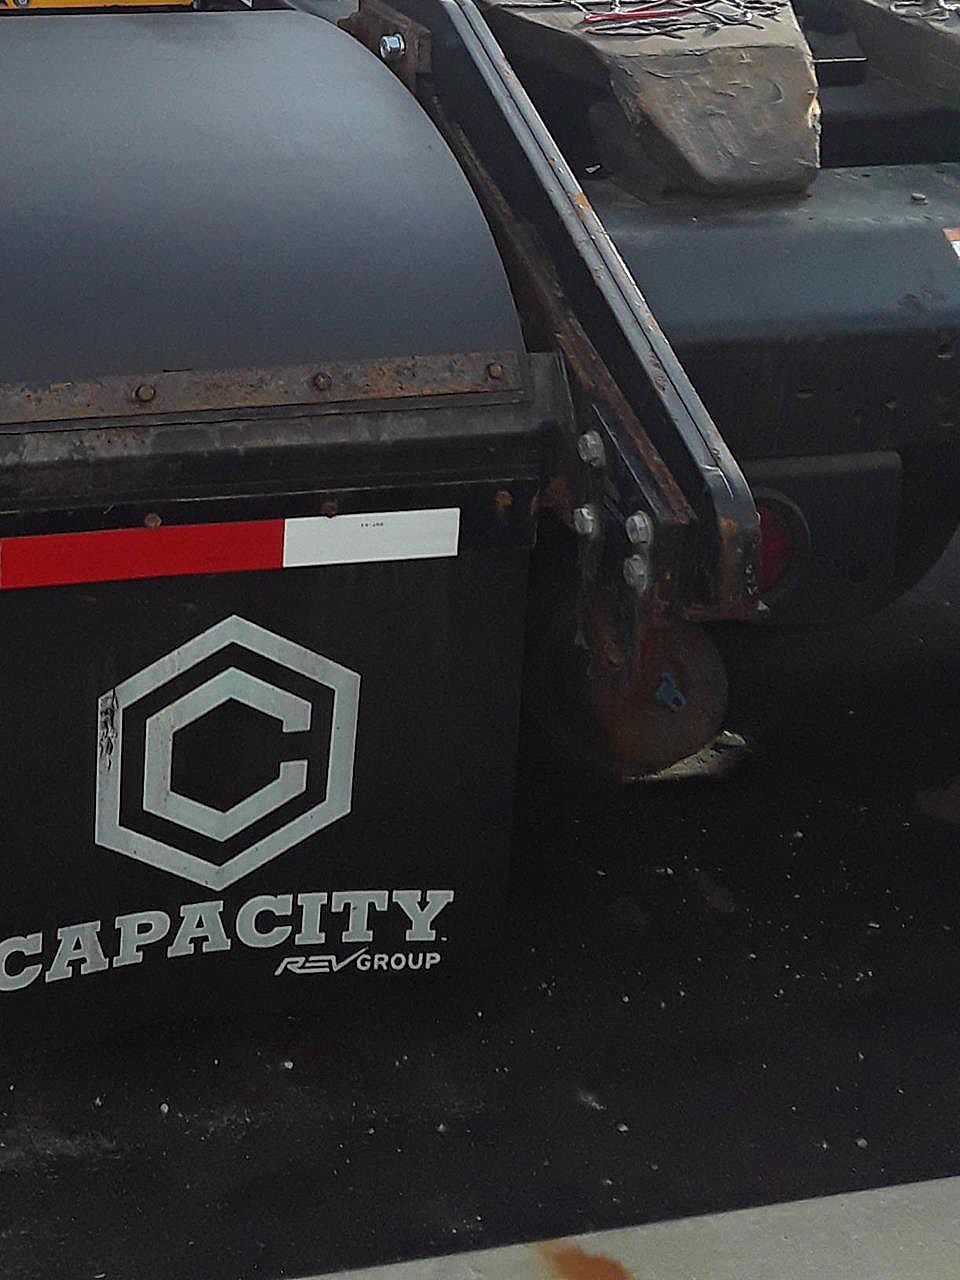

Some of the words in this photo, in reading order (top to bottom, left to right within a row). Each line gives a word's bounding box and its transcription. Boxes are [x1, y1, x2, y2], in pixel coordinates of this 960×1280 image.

[142, 666, 312, 843] C
[274, 946, 369, 976] REV
[356, 952, 441, 972] GROUP
